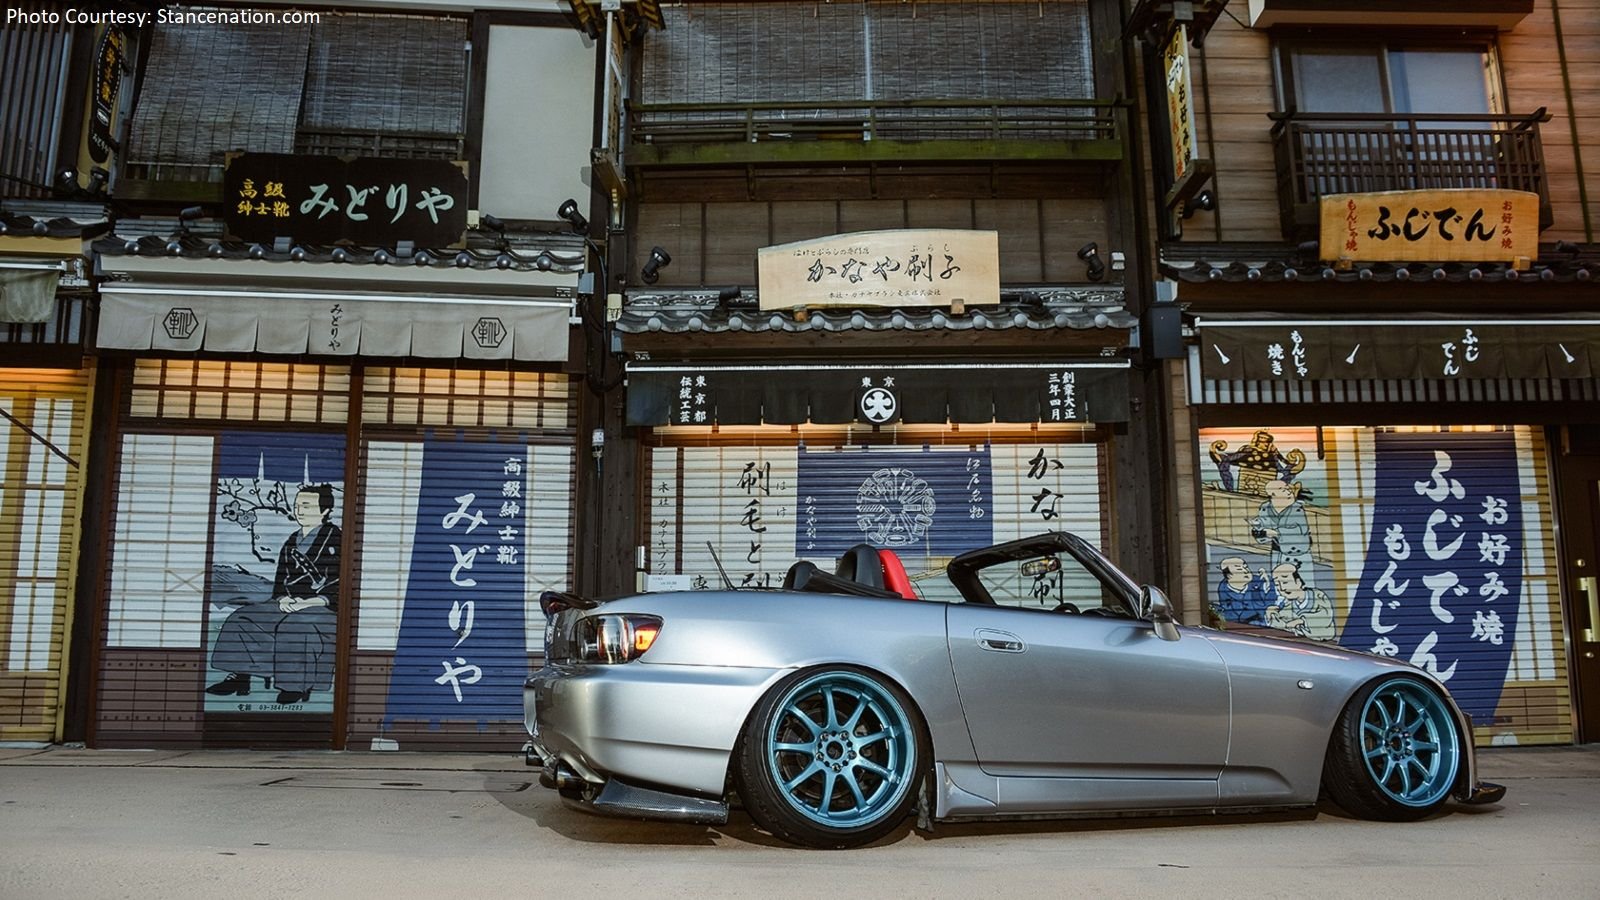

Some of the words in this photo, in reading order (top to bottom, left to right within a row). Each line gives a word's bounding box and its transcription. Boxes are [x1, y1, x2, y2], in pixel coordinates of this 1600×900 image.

[237, 202, 290, 217] 紳士靴
[239, 178, 287, 198] 高級
[300, 183, 454, 225] みどりや
[1345, 199, 1358, 252] もんじゃ焼
[1368, 206, 1497, 242] ふじでん
[1501, 200, 1514, 250] お好み焼
[806, 254, 961, 284] かなや刷子
[328, 303, 343, 351] みどりや
[1462, 328, 1479, 362] ふじ
[1267, 343, 1285, 376] 焼き
[1291, 330, 1308, 377] もんじゃ
[1441, 342, 1460, 376] でん
[679, 375, 692, 423] 伝統工芸
[694, 374, 707, 423] 東京都
[861, 375, 895, 388] 東京
[1048, 372, 1061, 421] 三年四月
[1062, 371, 1077, 420] 創業大正
[496, 457, 523, 565] 高級紳士靴
[1370, 523, 1411, 658] もんじゃ
[1408, 450, 1469, 684] ふじでん
[1470, 495, 1511, 645] お好み焼
[434, 492, 491, 702] みどりや
